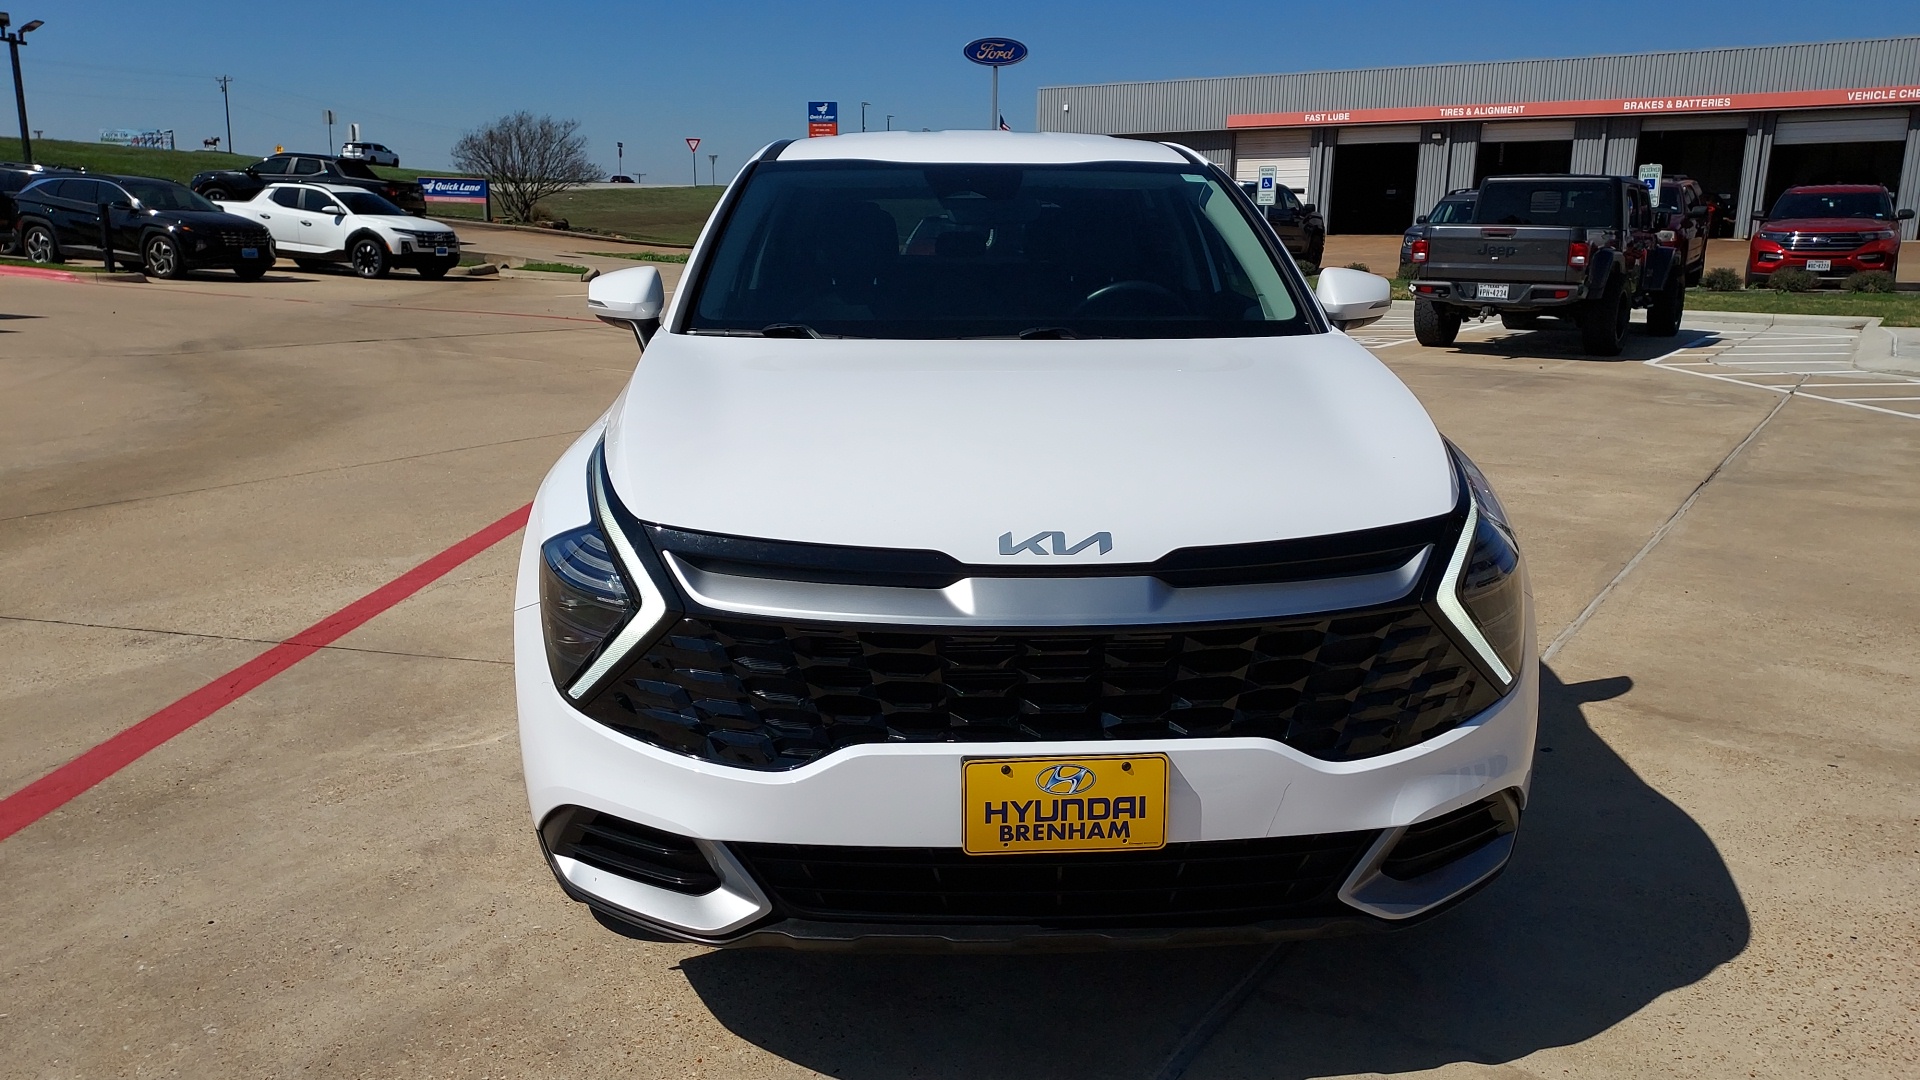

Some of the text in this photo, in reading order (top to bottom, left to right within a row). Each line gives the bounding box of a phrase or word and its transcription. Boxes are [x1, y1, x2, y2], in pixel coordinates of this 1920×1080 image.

[976, 42, 1015, 59] Ford
[1847, 88, 1920, 101] VEHICLE CHE
[1439, 105, 1525, 117] TIRES & ALIGNMENT
[1623, 97, 1731, 111] BRAKES & BATTERIES
[1304, 112, 1350, 122] FAST LUBE
[435, 182, 481, 192] Quick Lane
[1477, 243, 1516, 258] Jeep
[998, 531, 1113, 556] KIA
[984, 795, 1147, 824] HYUNDAI
[999, 820, 1131, 842] BRENHAM
